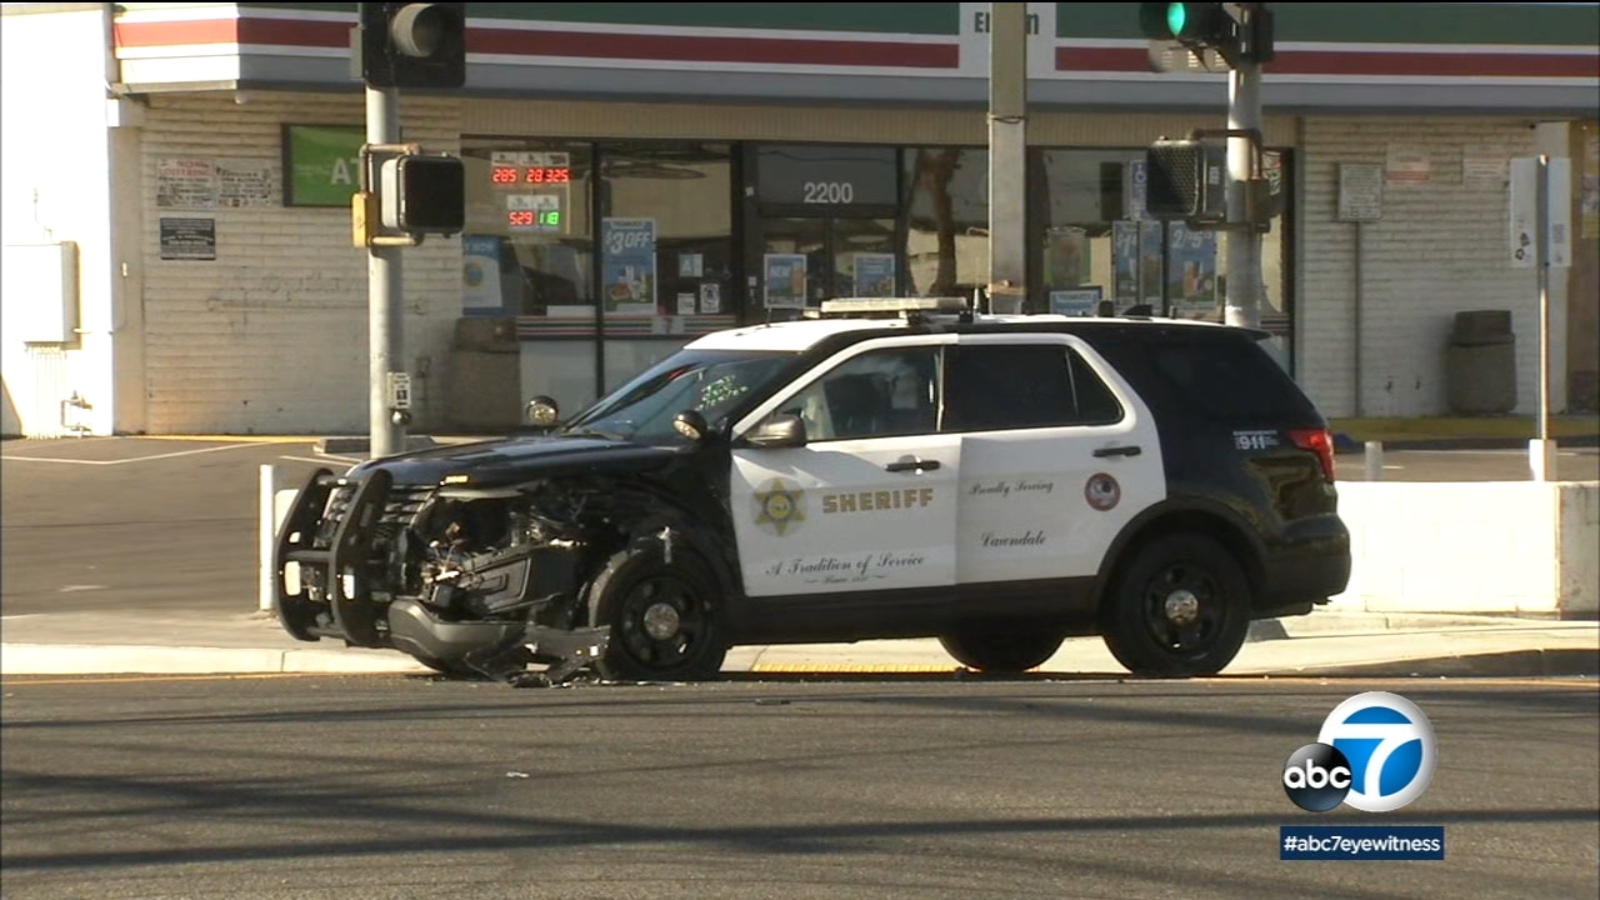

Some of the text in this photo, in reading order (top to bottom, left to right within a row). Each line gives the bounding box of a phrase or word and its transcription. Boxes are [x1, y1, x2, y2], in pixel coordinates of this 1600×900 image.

[493, 169, 516, 182] 285
[803, 182, 853, 203] 2200
[509, 211, 533, 225] 529
[625, 231, 650, 248] OFF
[1239, 435, 1265, 450] 911
[969, 480, 1053, 497] Proudly Serving
[823, 488, 934, 514] SHERIFF
[981, 530, 1047, 548] Lawndale
[765, 552, 925, 576] A Tradition of Service
